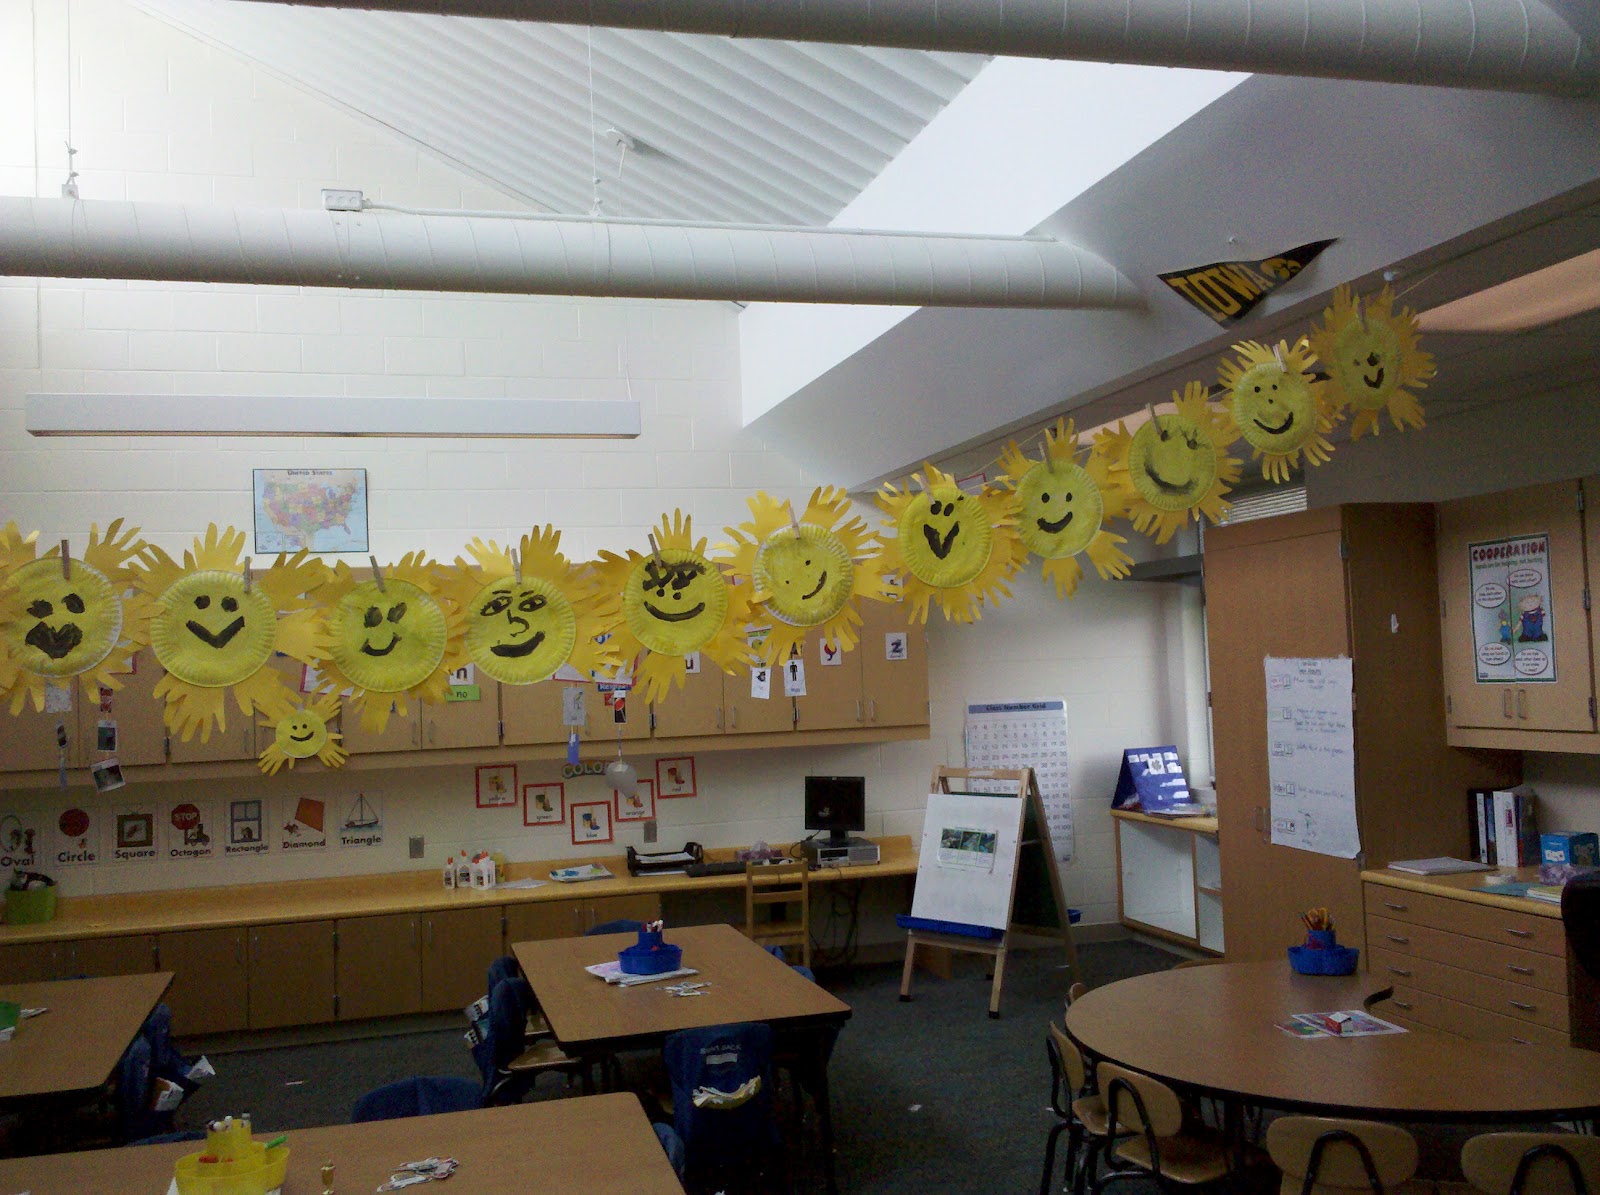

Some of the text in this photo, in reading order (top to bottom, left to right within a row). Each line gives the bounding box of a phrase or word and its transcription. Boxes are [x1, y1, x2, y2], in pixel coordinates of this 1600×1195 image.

[1166, 263, 1274, 322] IOWA
[1472, 541, 1546, 561] COOPERATION
[562, 761, 609, 779] COLO
[173, 812, 198, 821] STOP
[283, 838, 326, 849] Diamond
[341, 836, 382, 847] Triangle
[170, 847, 211, 858] Octagon
[226, 843, 269, 853] Rectangle
[58, 850, 95, 863] Circle
[115, 849, 155, 860] Square
[0, 854, 34, 867] Oval
